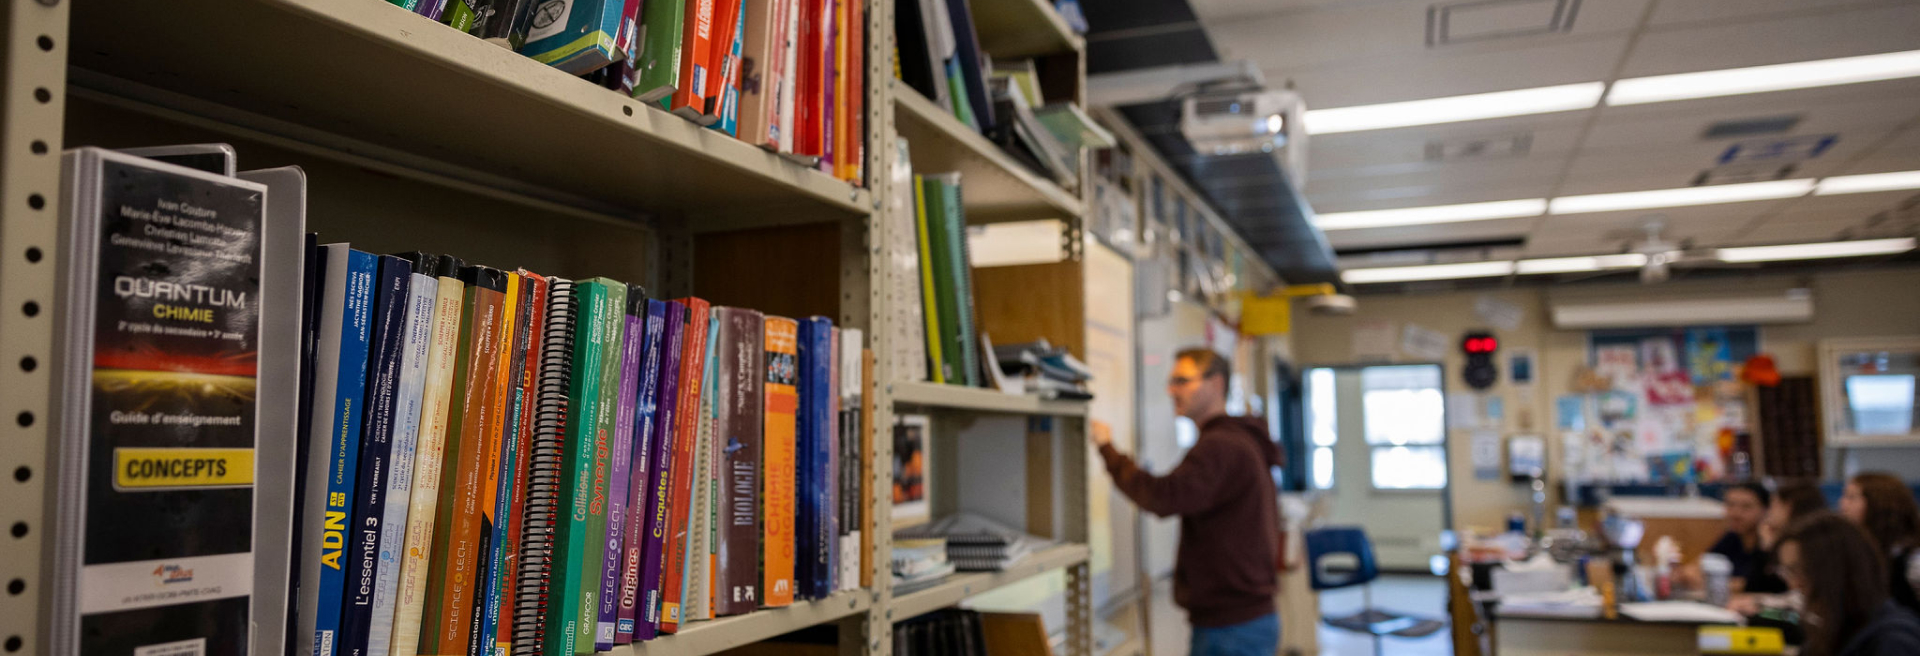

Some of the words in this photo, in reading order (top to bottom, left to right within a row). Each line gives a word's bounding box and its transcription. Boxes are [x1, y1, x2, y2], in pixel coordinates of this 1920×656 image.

[115, 276, 247, 309] QUANTUM
[356, 272, 364, 298] GAGNON
[153, 304, 215, 323] CHIMIE
[411, 320, 420, 344] SCHEPPER
[378, 373, 387, 410] TECHNOLOGIE
[110, 410, 150, 424] Guide
[152, 412, 241, 428] d'enseignement
[338, 398, 351, 457] D'APPRENTISSAGE
[662, 410, 671, 450] d'apprentissage
[402, 432, 410, 461] secondaire
[430, 432, 438, 460] secondaire
[127, 458, 228, 480] CONCEPTS
[336, 459, 345, 484] CAHIER
[372, 457, 381, 488] VERREAULT
[471, 462, 480, 498] d'apprentissage
[589, 429, 608, 516] Synergie
[574, 471, 588, 522] Collisions
[653, 470, 668, 538] Conquêtes
[733, 460, 754, 525] BIOLOGIE
[767, 462, 780, 536] CHIMIE
[782, 437, 793, 558] ORGANIQUE
[321, 510, 346, 570] ADN
[355, 530, 376, 605] L'essentiel
[366, 516, 378, 527] 3
[622, 548, 640, 608] Origines
[604, 552, 616, 614] SCIENCE
[583, 592, 592, 634] GRAFICOR
